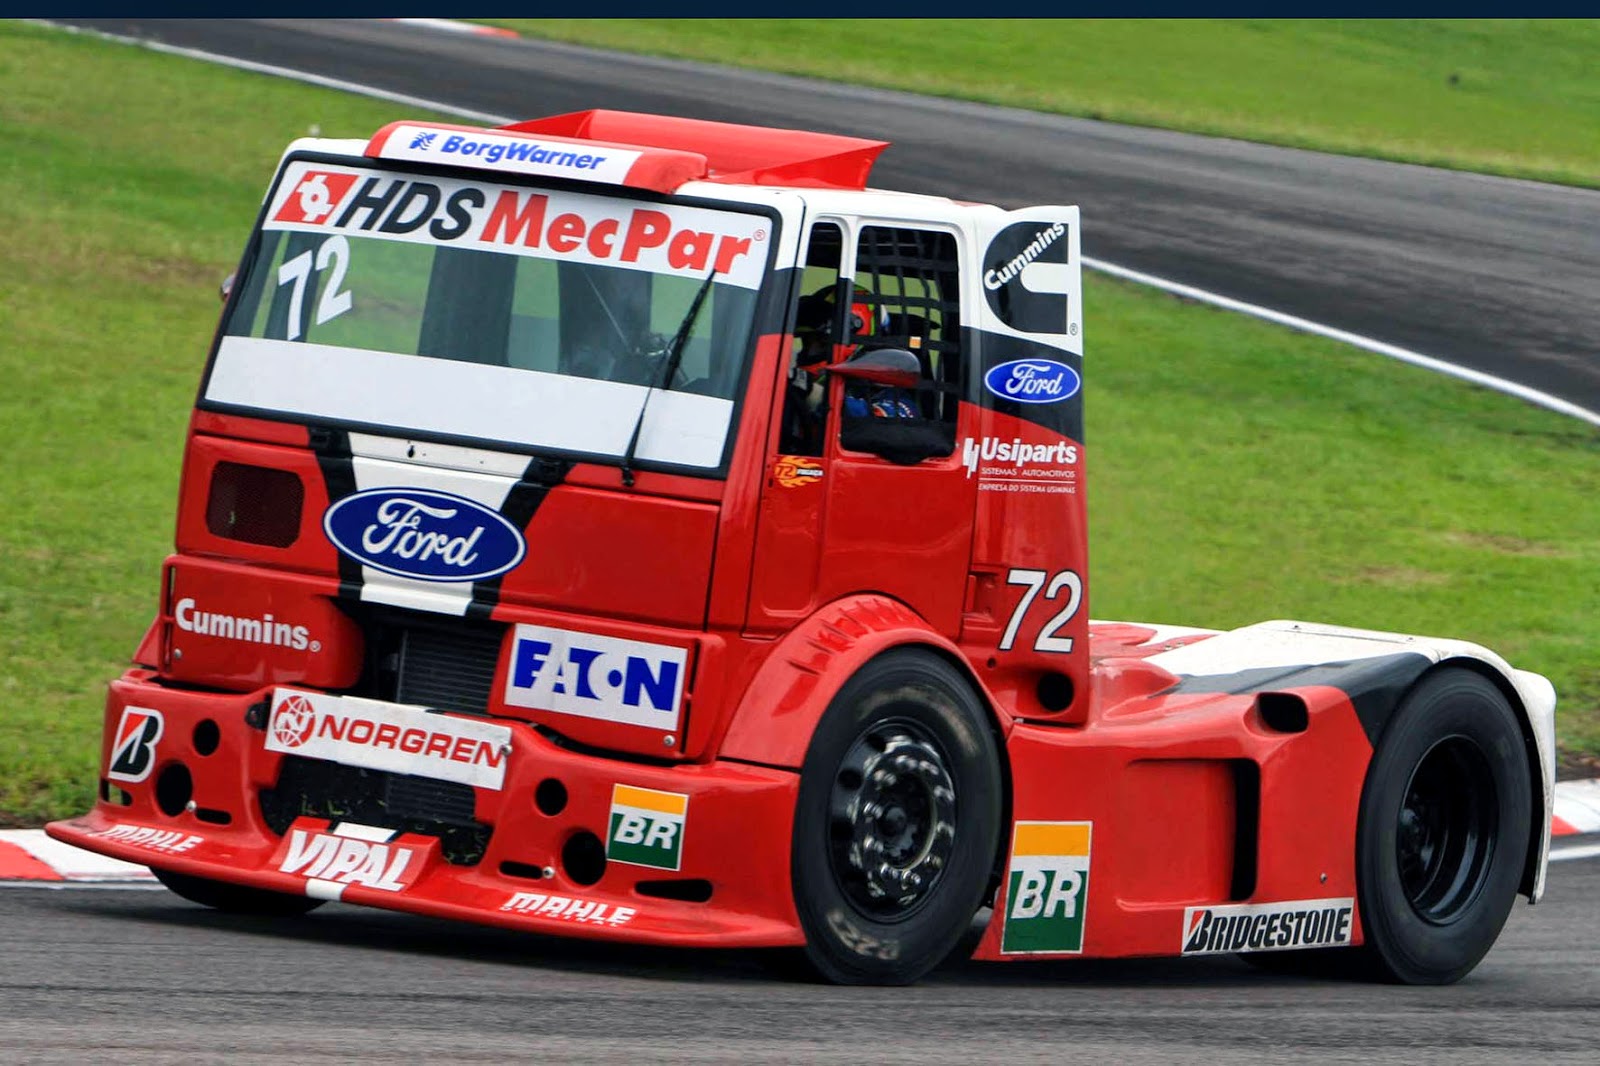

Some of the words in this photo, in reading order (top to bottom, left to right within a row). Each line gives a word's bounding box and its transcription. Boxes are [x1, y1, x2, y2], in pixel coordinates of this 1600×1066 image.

[440, 135, 607, 170] BorgWarner
[984, 221, 1066, 291] Cummins
[277, 235, 353, 341] 72
[1004, 362, 1065, 396] Ford
[981, 437, 1077, 467] Usiparts
[981, 467, 1017, 476] SISTEMAS
[1021, 469, 1075, 478] AUTOMOTIVOS
[362, 499, 485, 568] Ford
[175, 597, 309, 651] Cummins
[1000, 569, 1082, 653] 72
[514, 639, 679, 711] EATON
[318, 714, 502, 768] NORGREN
[88, 824, 205, 852] MAHLE
[614, 817, 677, 850] BR
[279, 829, 413, 892] VIPAL
[503, 892, 637, 924] MAHLE
[1010, 868, 1083, 919] BR
[1182, 907, 1352, 953] BRIDGESTONE
